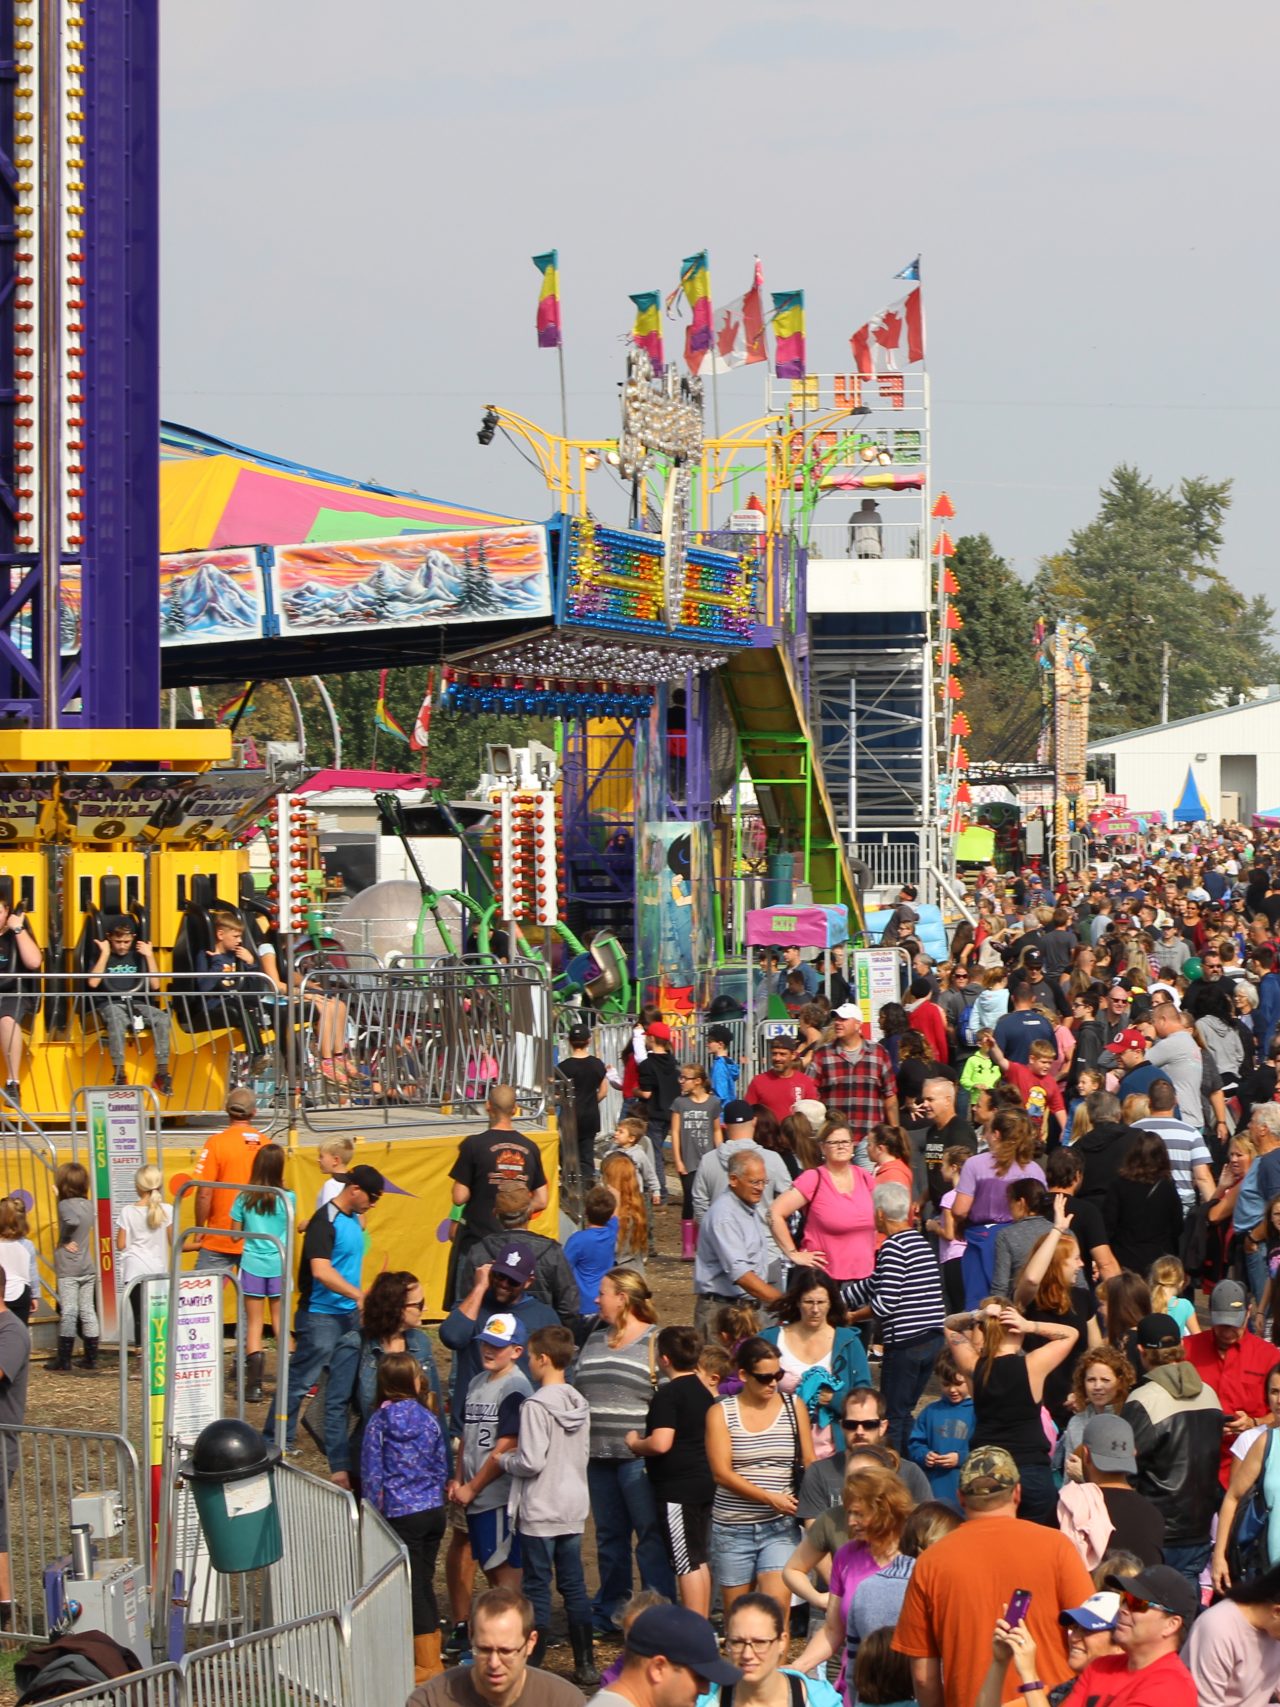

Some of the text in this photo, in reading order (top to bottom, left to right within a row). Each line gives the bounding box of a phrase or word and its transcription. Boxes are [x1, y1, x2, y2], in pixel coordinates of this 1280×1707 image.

[768, 1024, 798, 1037] EXI
[94, 1117, 106, 1168] YES
[100, 1237, 111, 1271] NO
[178, 1294, 213, 1308] CRAMBLER
[151, 1316, 167, 1388] YES
[176, 1343, 210, 1352] COUPONS
[191, 1351, 208, 1360] RIDE
[175, 1369, 213, 1380] SAFETY
